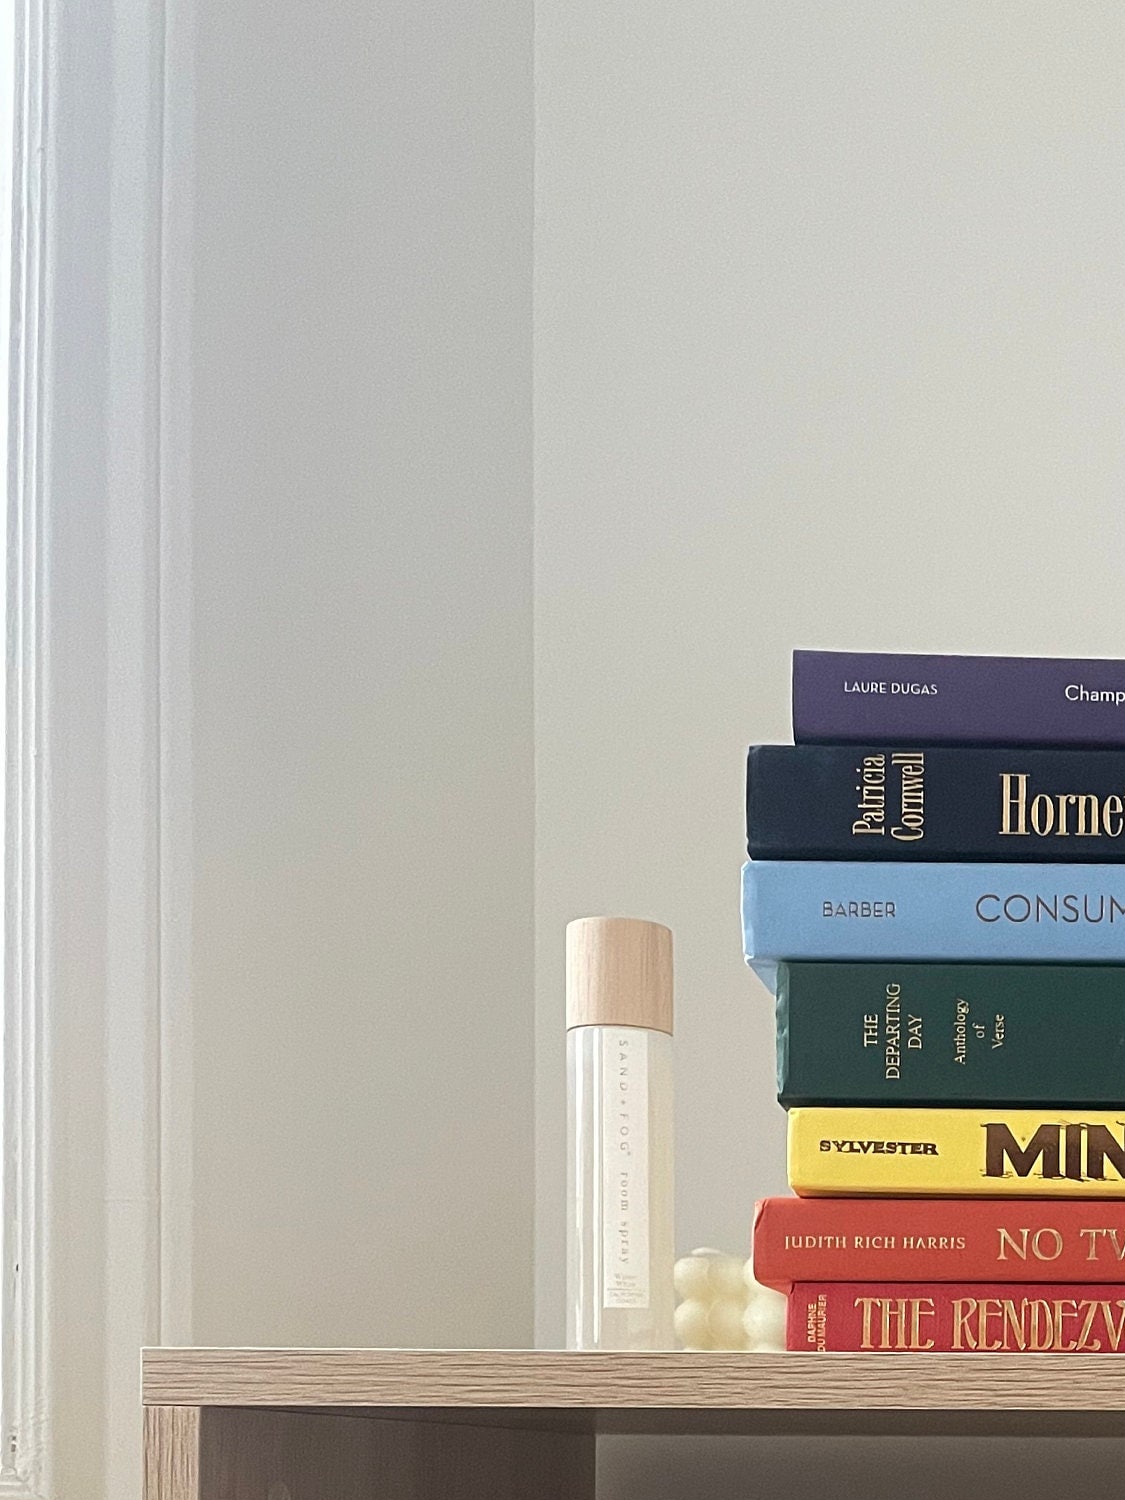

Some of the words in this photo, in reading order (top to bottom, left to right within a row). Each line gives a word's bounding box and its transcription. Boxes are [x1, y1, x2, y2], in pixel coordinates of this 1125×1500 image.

[844, 681, 887, 694] LAURE
[891, 682, 938, 696] DUGAS
[852, 754, 885, 835] Patricia
[891, 753, 924, 841] Cornwell
[823, 901, 896, 918] BARBER
[863, 1014, 878, 1047] THE
[885, 983, 901, 1080] DEPARTING
[908, 1014, 922, 1050] DAY
[954, 998, 970, 1065] Anthology
[973, 1022, 985, 1039] of
[991, 1013, 1005, 1049] Verse
[619, 1040, 628, 1091] SAND
[819, 1140, 938, 1156] SYLVESTER
[621, 1172, 629, 1211] room
[619, 1221, 629, 1263] spray
[784, 1235, 847, 1250] JUDITH
[854, 1236, 896, 1249] RICH
[903, 1236, 966, 1249] HARRIS
[996, 1228, 1063, 1261] NO
[807, 1303, 817, 1343] DAPHNE
[818, 1295, 827, 1335] MAURIER
[854, 1297, 936, 1350] THE
[817, 1336, 826, 1352] DU
